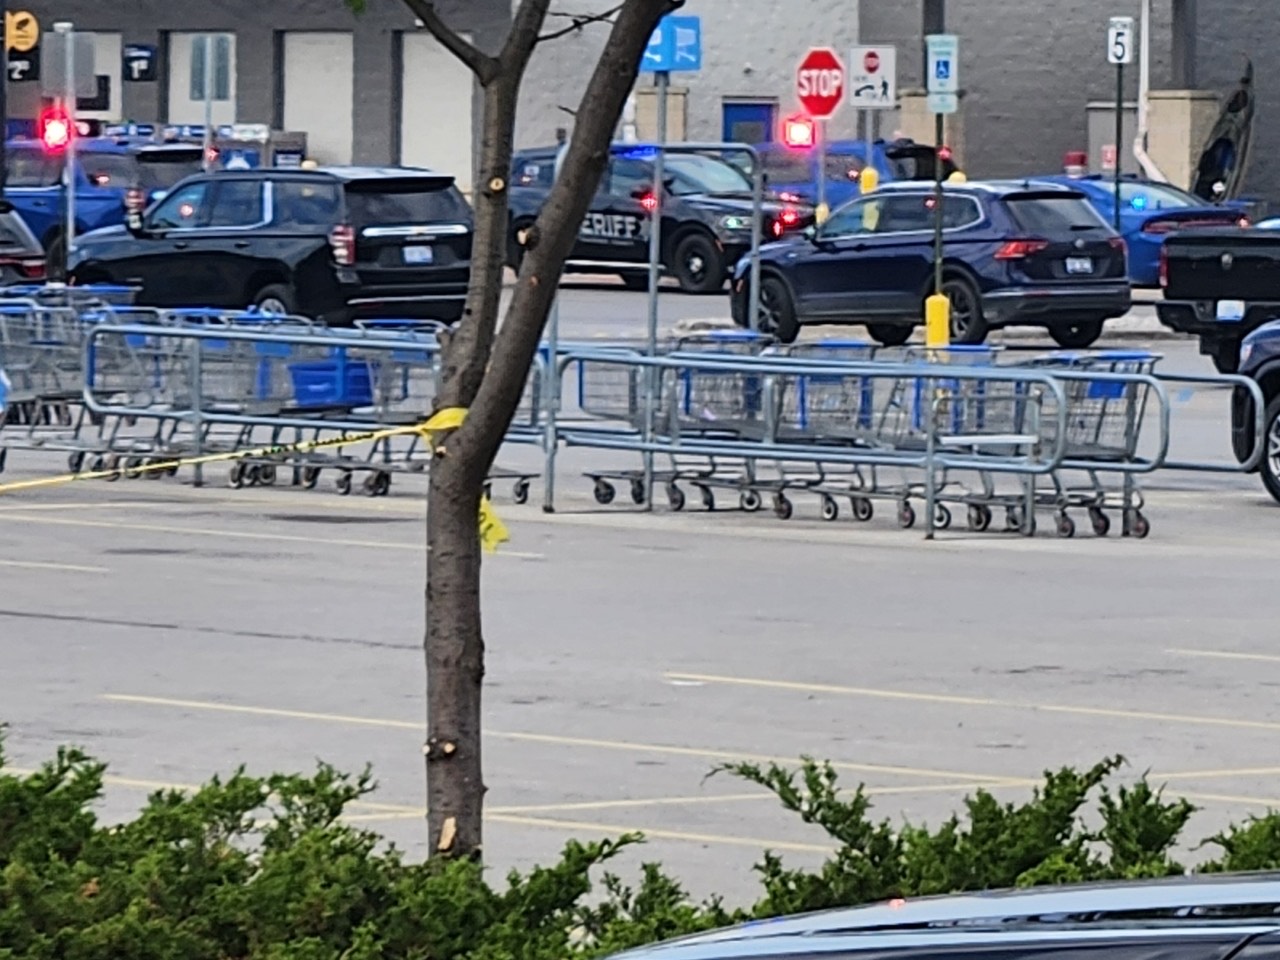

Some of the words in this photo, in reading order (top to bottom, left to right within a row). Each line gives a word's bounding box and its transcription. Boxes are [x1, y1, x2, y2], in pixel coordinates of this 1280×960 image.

[1113, 31, 1126, 61] 5
[799, 68, 842, 97] STOP
[580, 212, 637, 239] ERIFF
